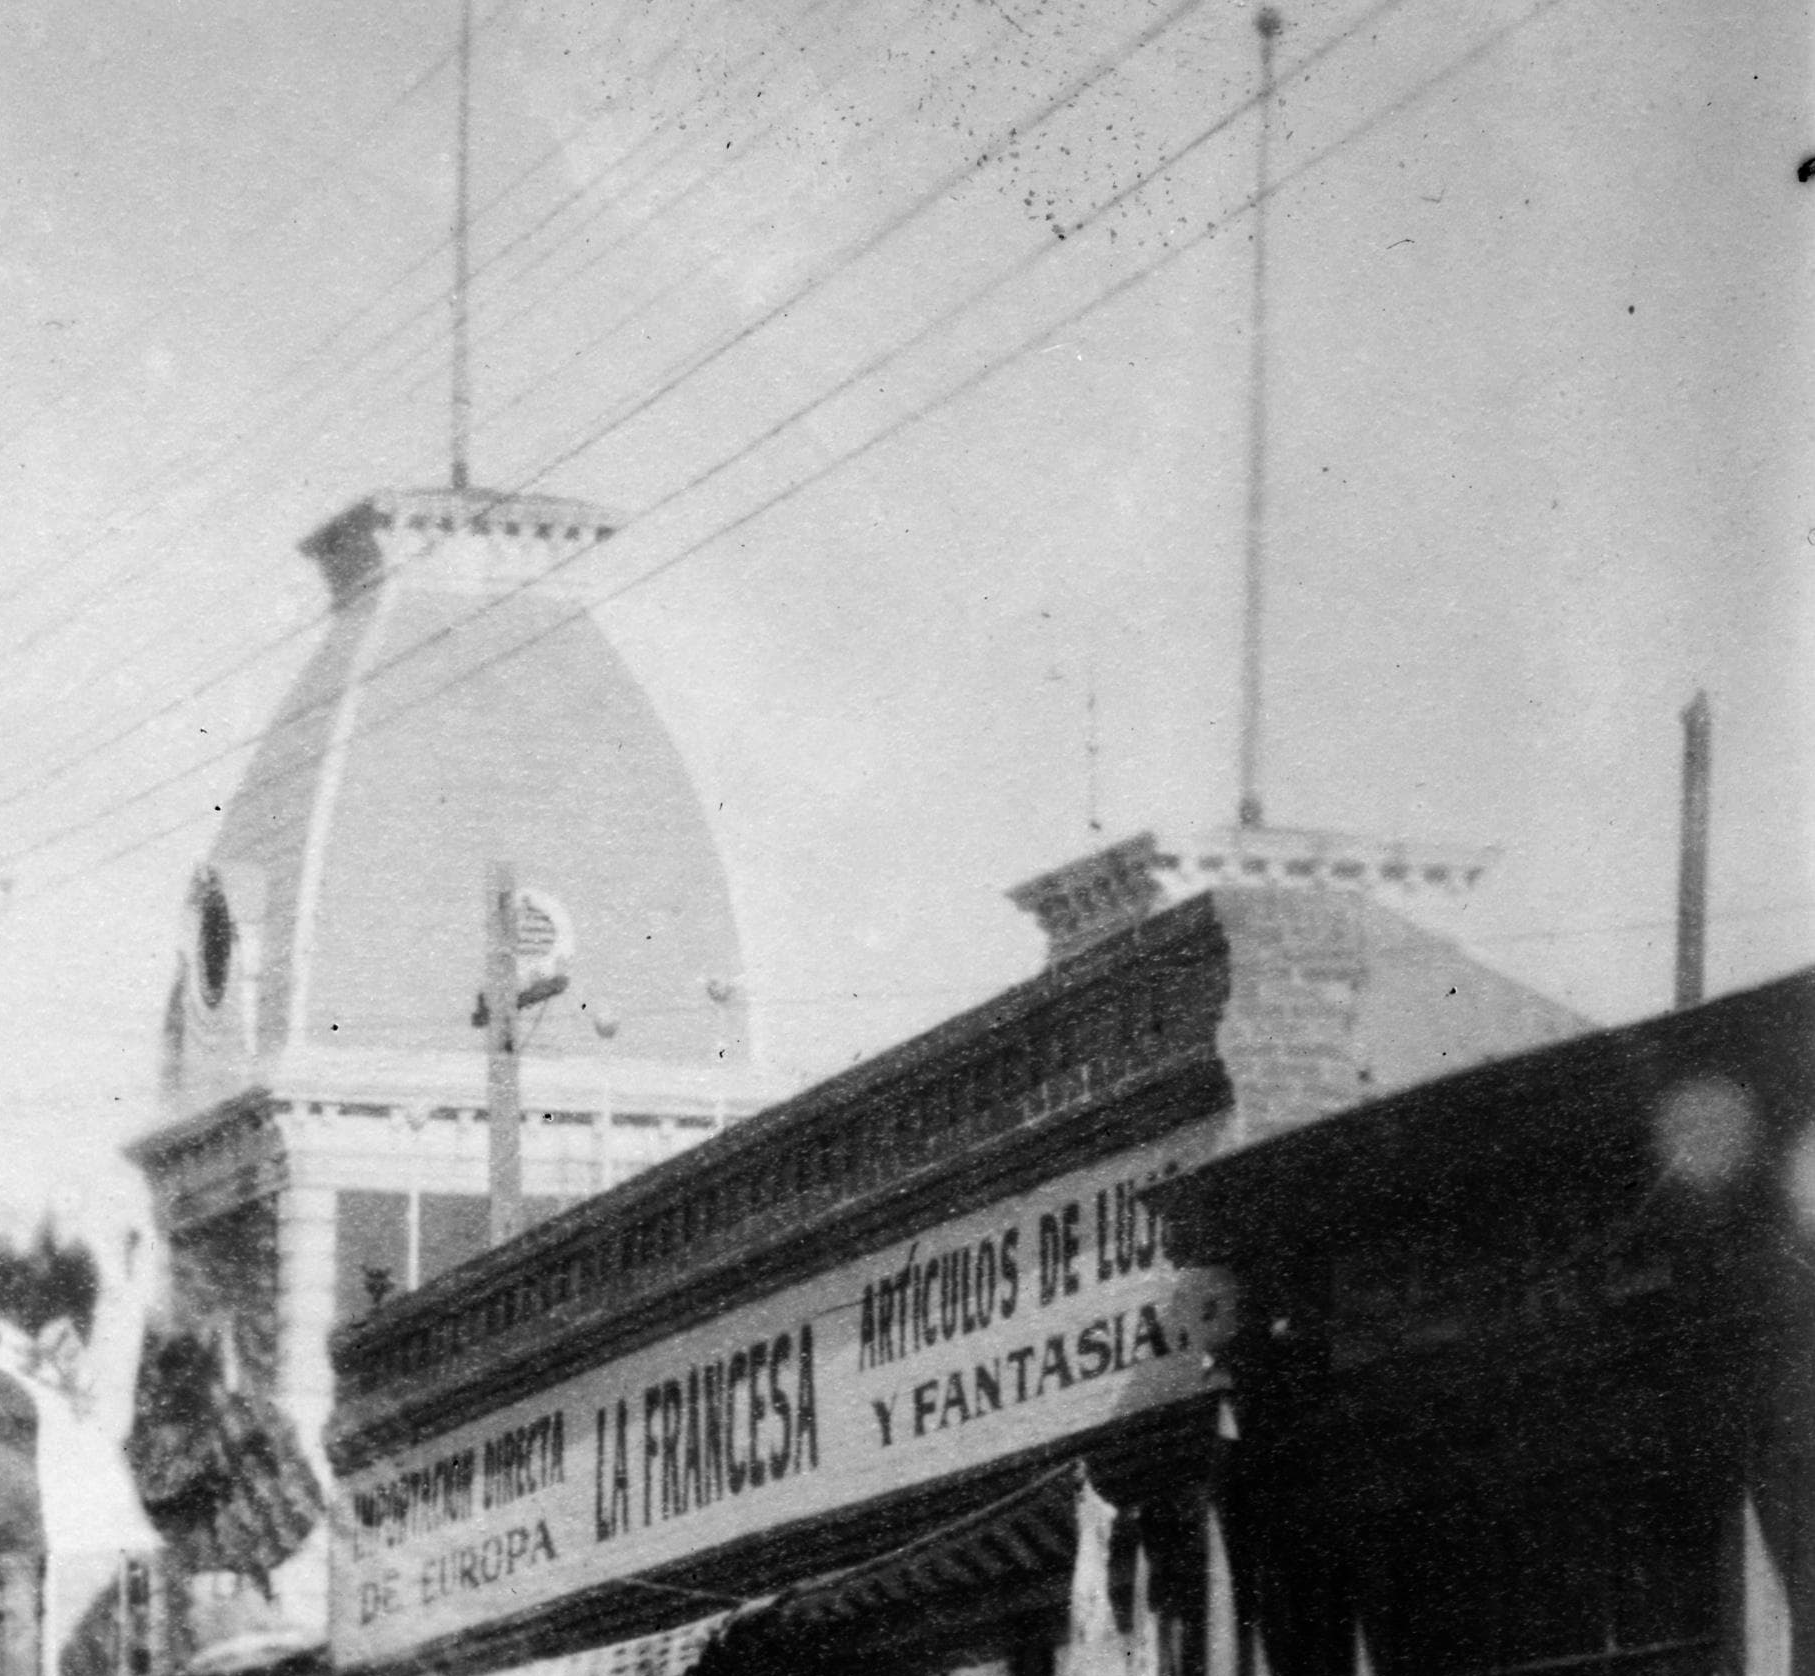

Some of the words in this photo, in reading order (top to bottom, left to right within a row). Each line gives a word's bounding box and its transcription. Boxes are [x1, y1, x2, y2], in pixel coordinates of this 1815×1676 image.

[860, 1226, 1020, 1372] ARTÍCULOS
[1039, 1201, 1081, 1307] DE
[595, 1398, 629, 1542] LA
[642, 1322, 820, 1527] FRANCESA
[871, 1394, 898, 1447] Y
[420, 1518, 559, 1606] EUROPA
